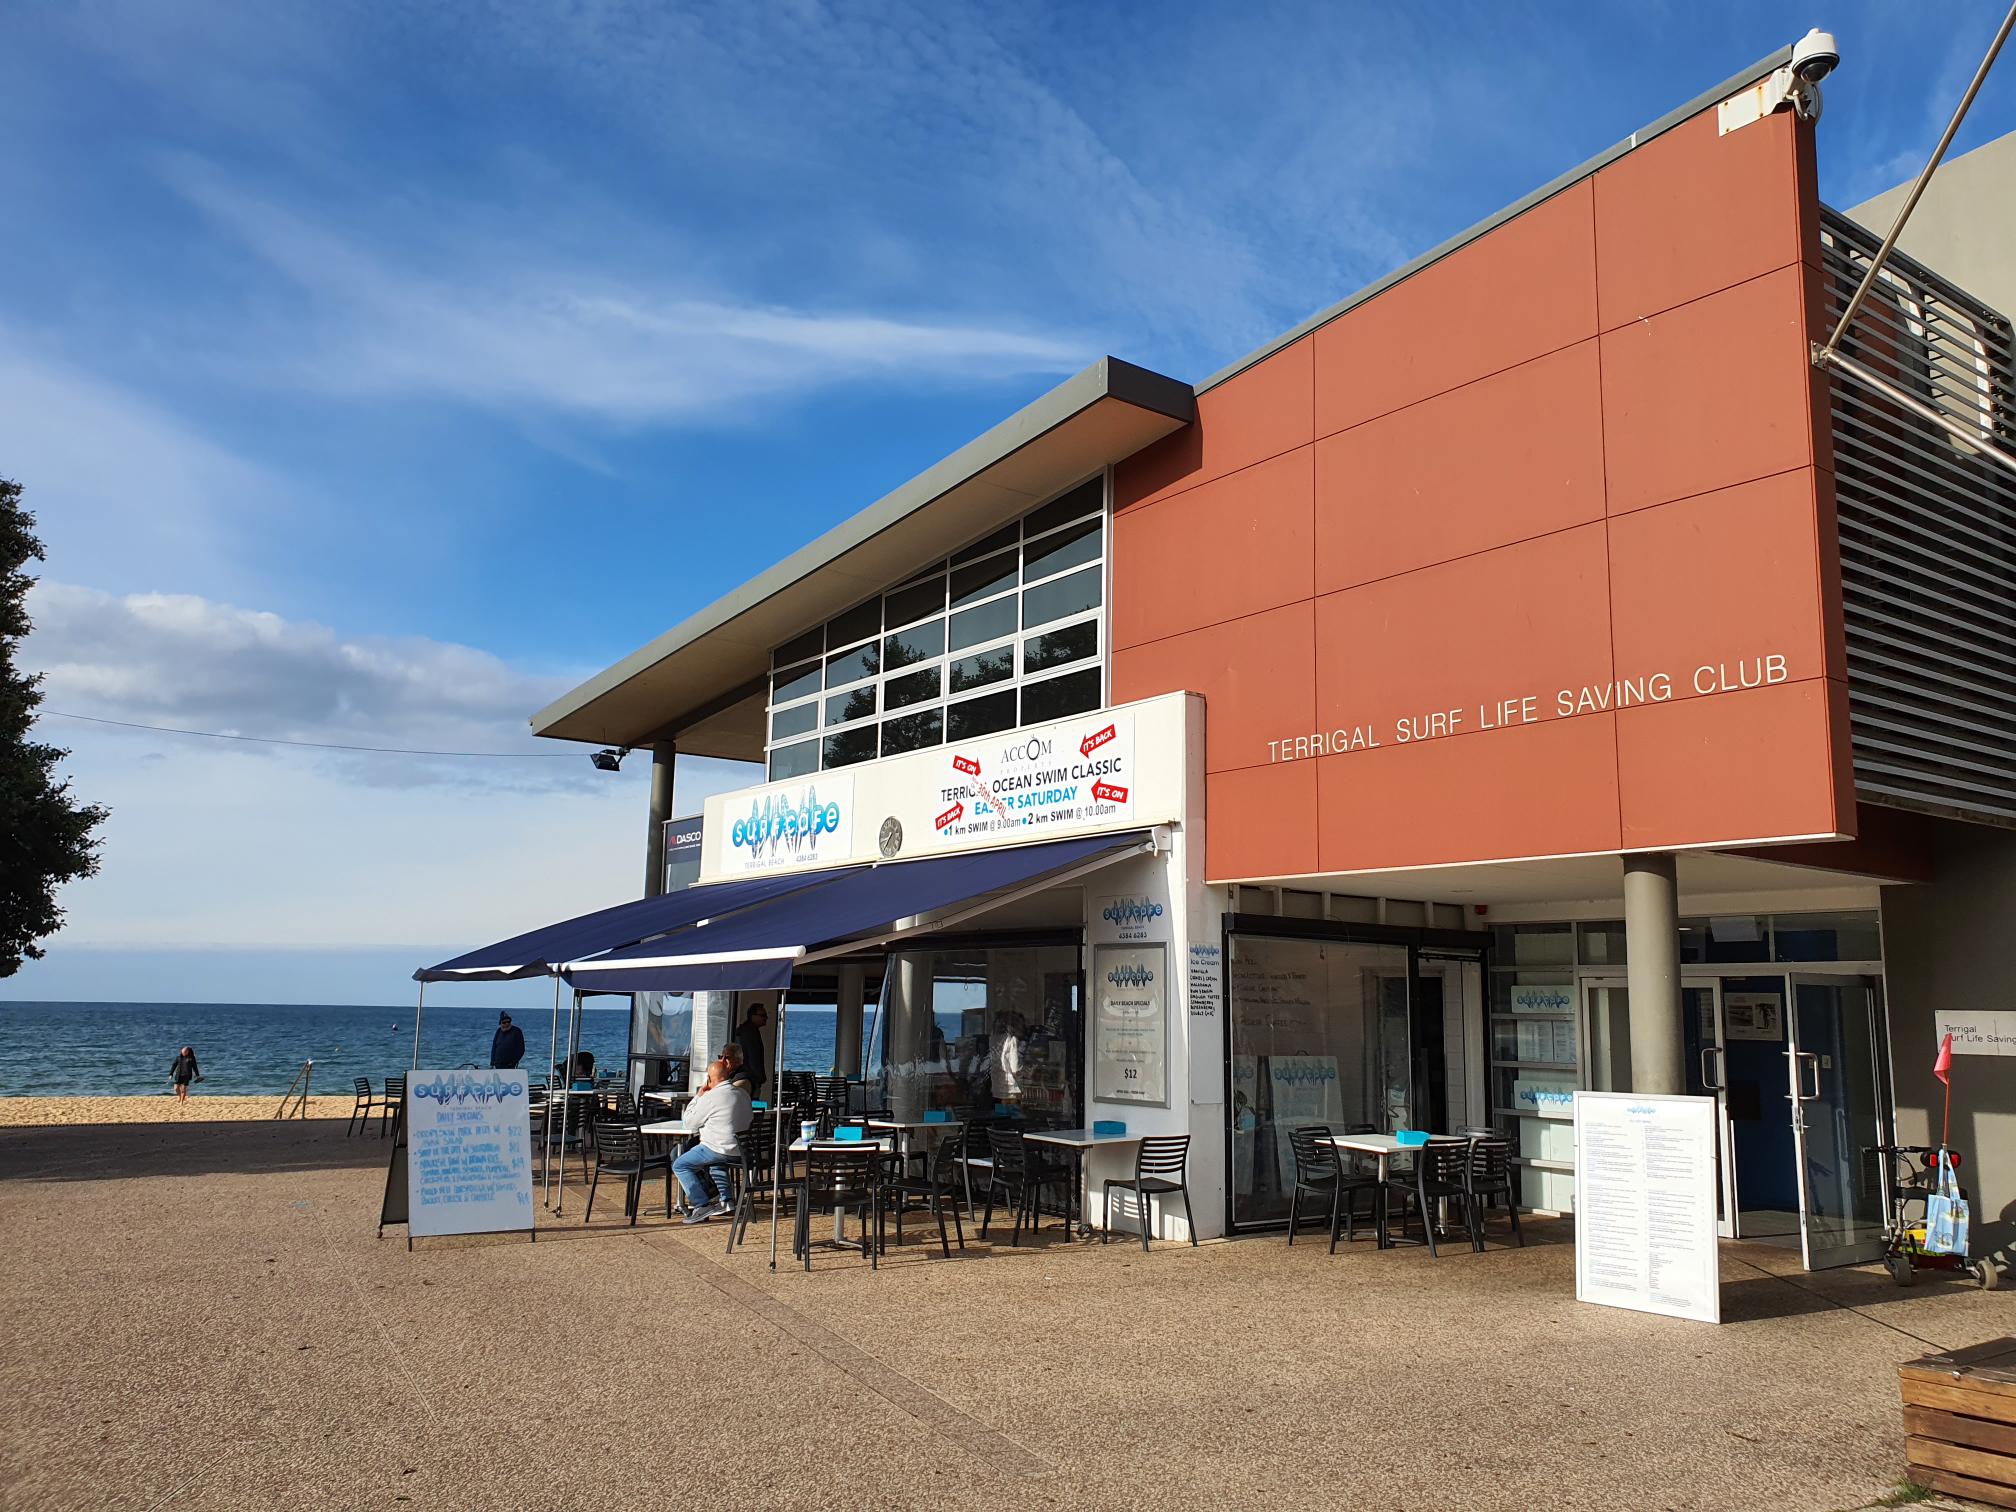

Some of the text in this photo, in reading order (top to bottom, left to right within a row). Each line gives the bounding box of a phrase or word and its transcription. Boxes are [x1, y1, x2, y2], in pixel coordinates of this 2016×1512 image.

[1268, 653, 1788, 763] TERRIGAL SURF LIFE SAVING CLUB
[1095, 729, 1113, 744] BACK
[1001, 739, 1052, 763] ACCOM
[966, 764, 977, 773] ON
[992, 774, 1032, 793] OCEAN
[1035, 767, 1068, 787] SWIM
[1071, 758, 1122, 780] CLASSIC
[1018, 786, 1078, 809] SATURDAY
[1111, 791, 1125, 800] ON
[955, 825, 966, 836] km
[968, 821, 988, 834] SWIM
[1036, 812, 1048, 824] km
[1050, 808, 1074, 822] SWIM
[677, 830, 701, 844] DASCO
[1944, 1024, 1977, 1034] Terrigal
[1950, 1034, 1964, 1042] urf
[1967, 1034, 1983, 1042] Life
[1124, 1067, 1138, 1079] $12
